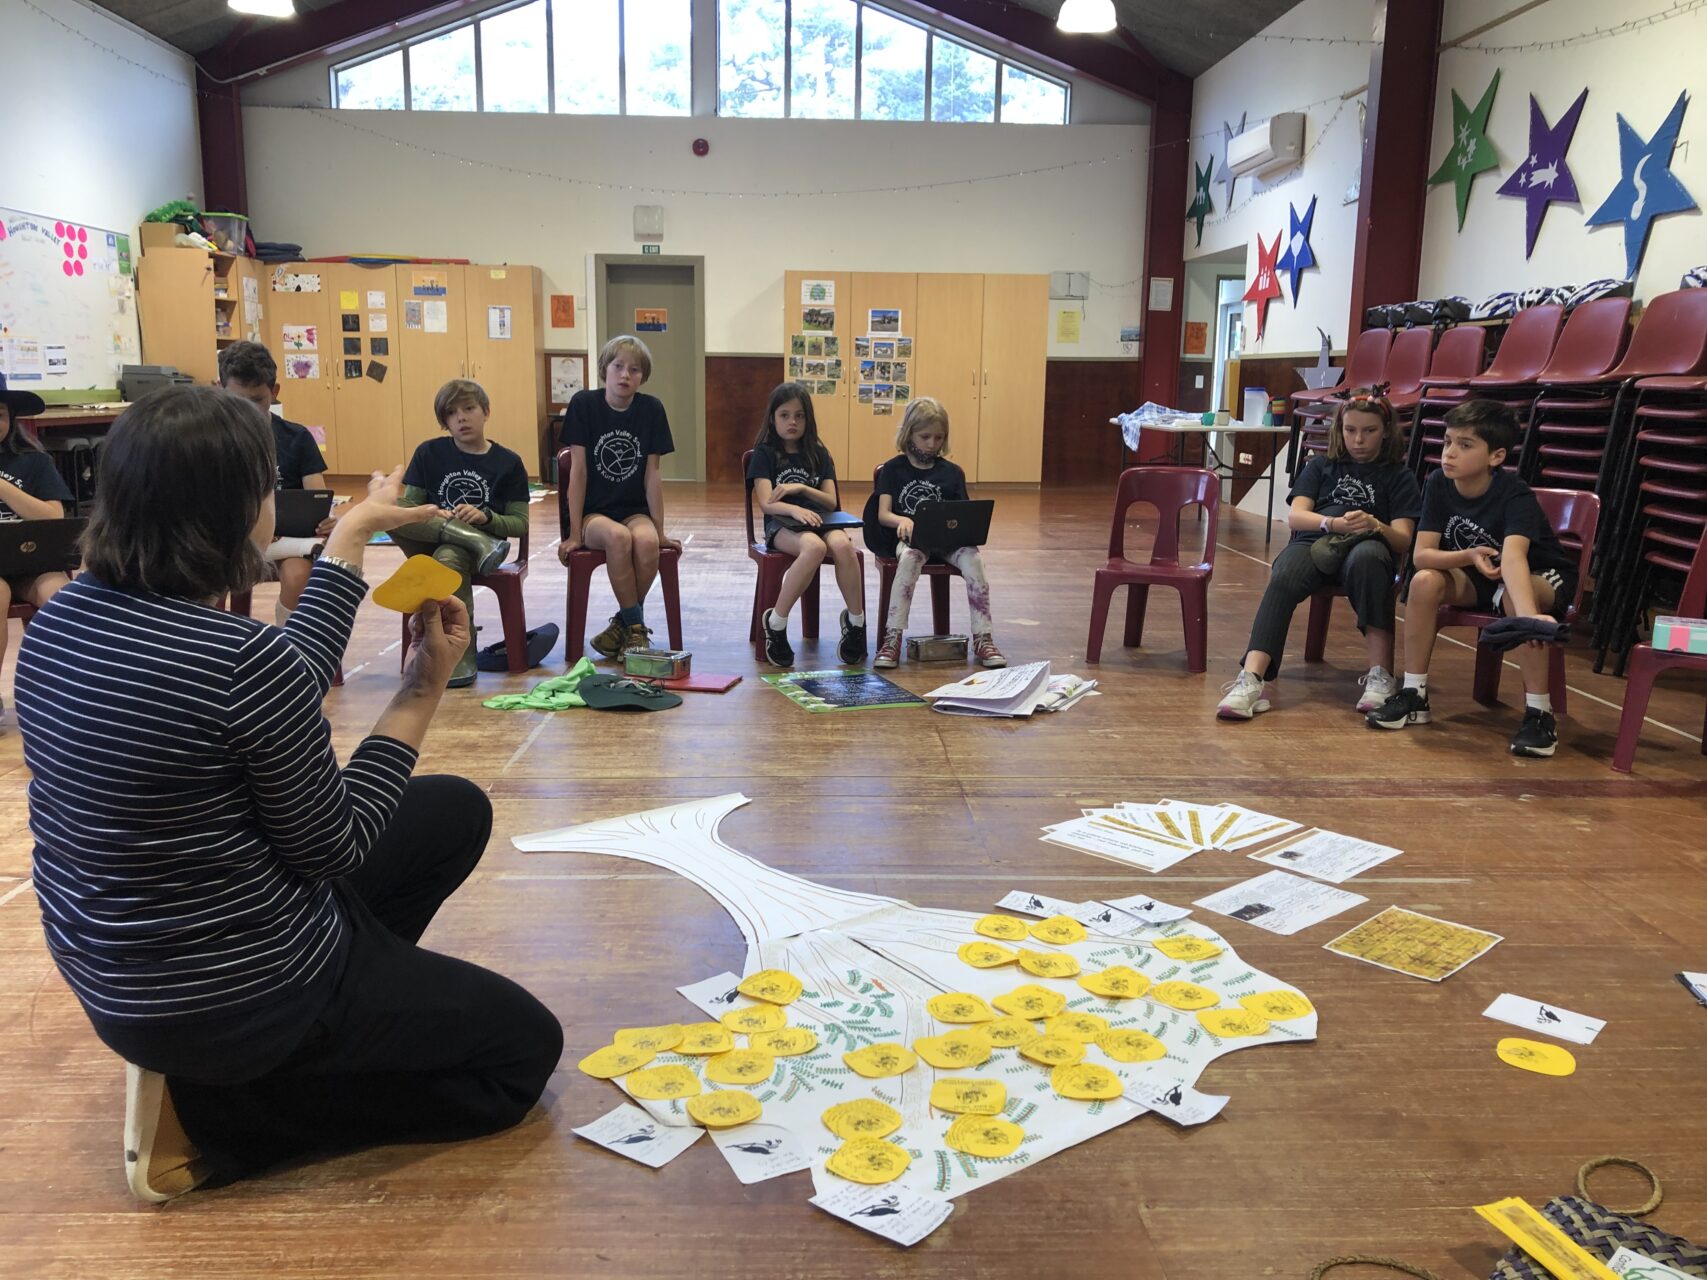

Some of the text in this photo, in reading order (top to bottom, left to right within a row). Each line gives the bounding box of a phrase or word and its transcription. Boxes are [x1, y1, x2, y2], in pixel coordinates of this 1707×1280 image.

[615, 429, 632, 440] Valley
[438, 469, 490, 502] Houghton Valley School
